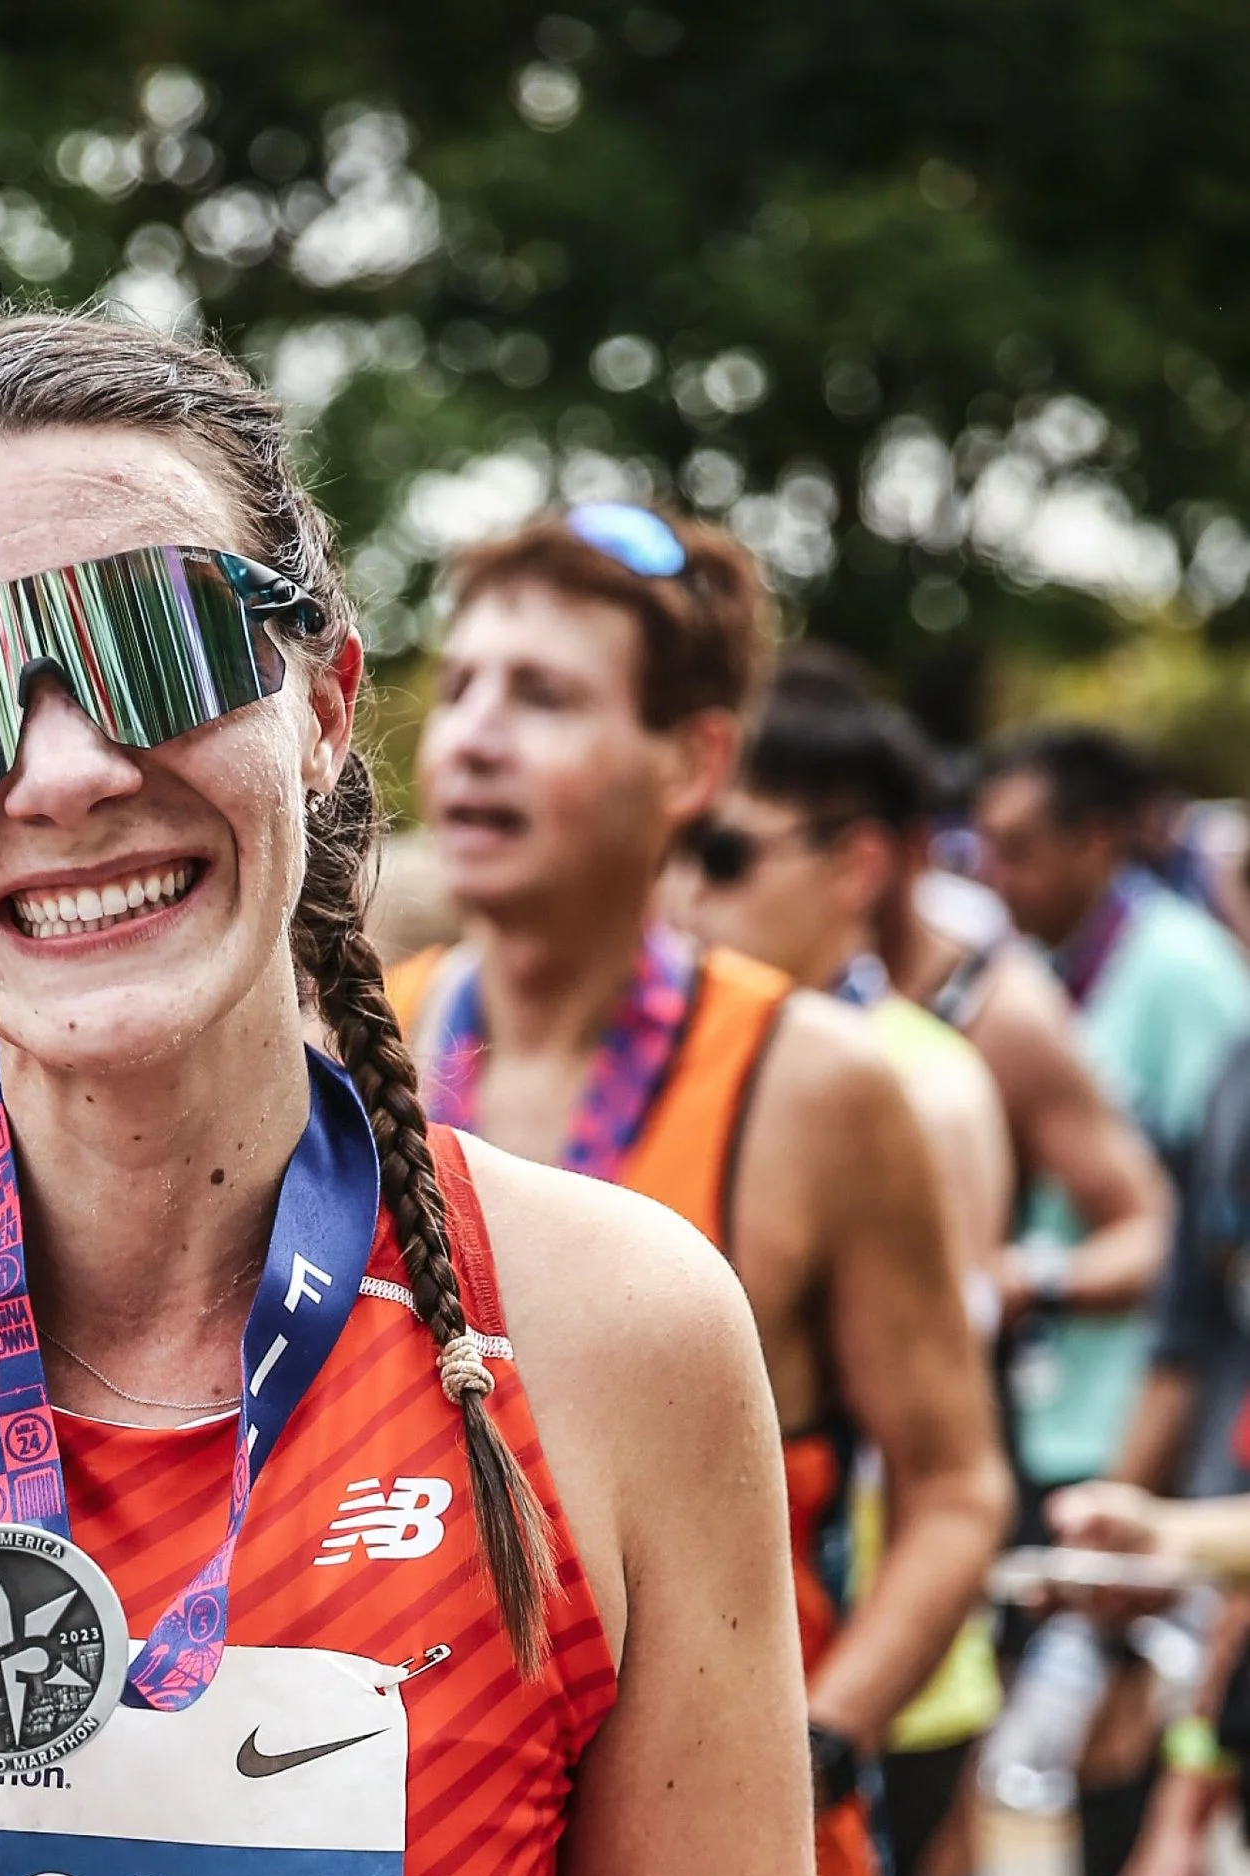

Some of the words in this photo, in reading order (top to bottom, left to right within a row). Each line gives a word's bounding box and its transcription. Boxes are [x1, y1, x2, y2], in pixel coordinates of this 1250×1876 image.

[16, 1432, 41, 1456] 24
[59, 1627, 100, 1645] 2023
[199, 1615, 209, 1635] 5
[13, 1716, 98, 1771] MARATHON
